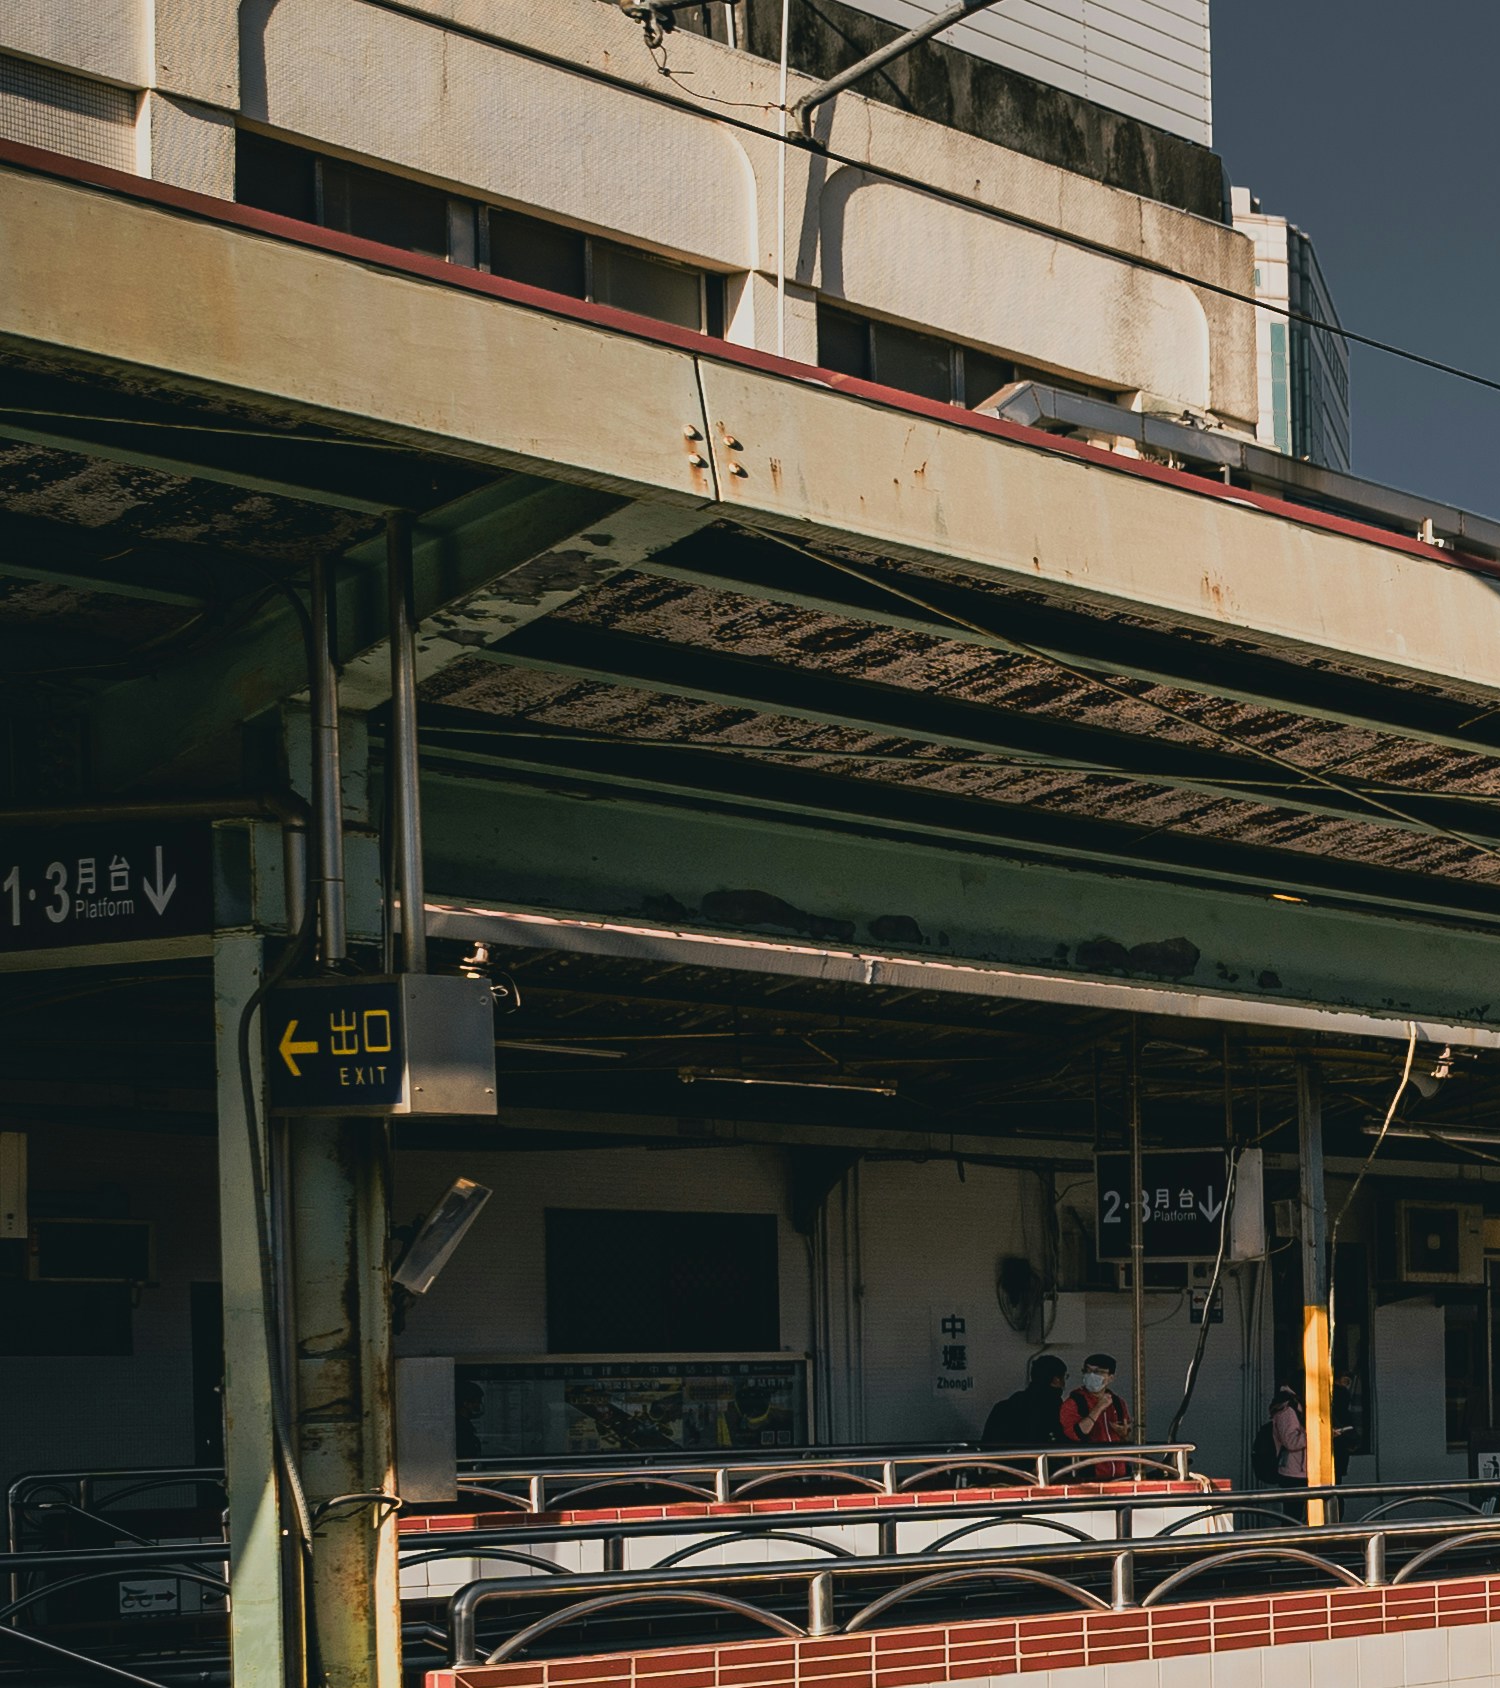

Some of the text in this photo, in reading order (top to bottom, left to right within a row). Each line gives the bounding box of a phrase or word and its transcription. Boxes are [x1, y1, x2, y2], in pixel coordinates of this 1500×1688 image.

[76, 855, 131, 895] 月台
[75, 897, 135, 920] Platform
[329, 1009, 392, 1056] 出口
[339, 1066, 389, 1086] EXIT
[1155, 1188, 1194, 1209] 月台
[1153, 1210, 1197, 1222] Platform
[941, 1314, 967, 1371] 中壢
[937, 1377, 974, 1391] Zhongli
